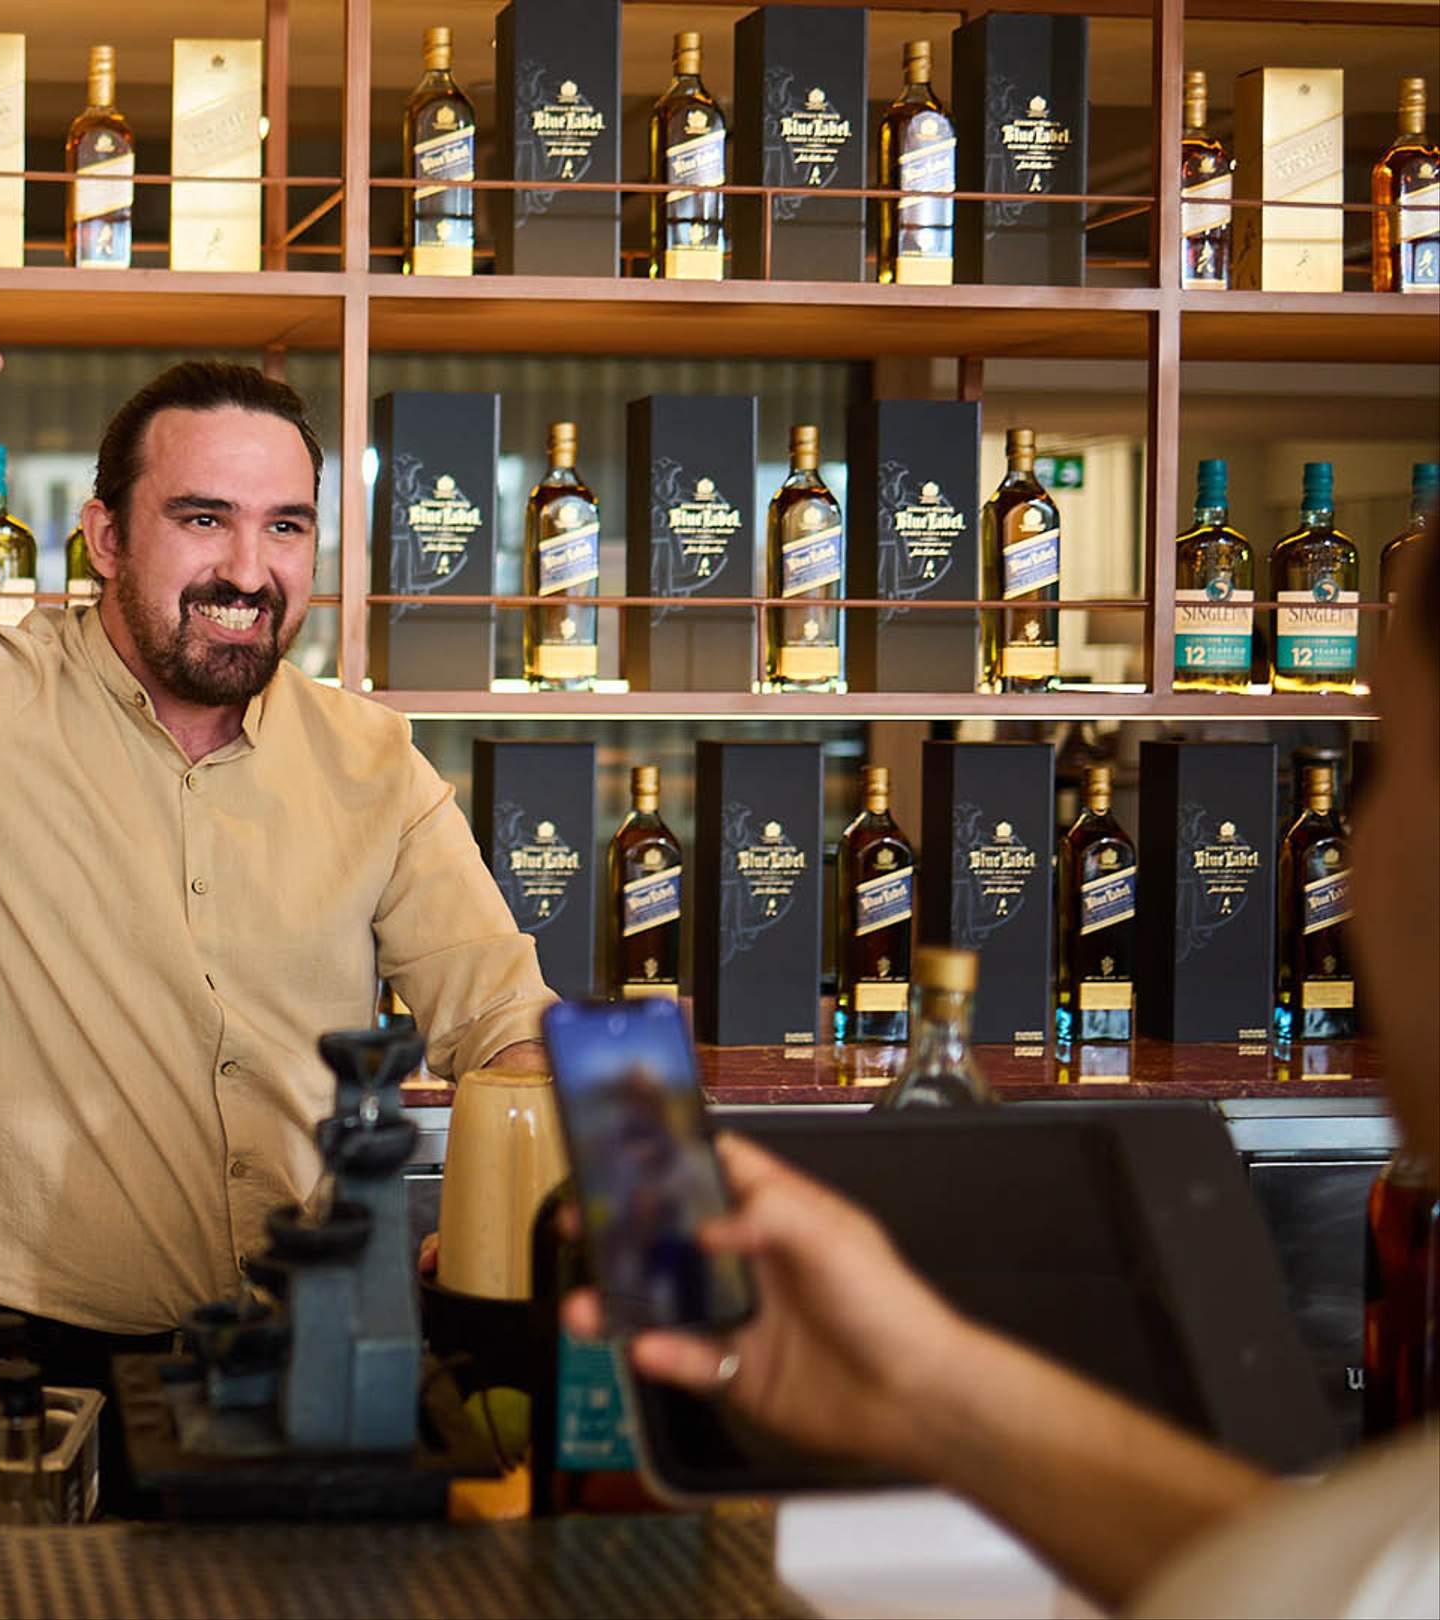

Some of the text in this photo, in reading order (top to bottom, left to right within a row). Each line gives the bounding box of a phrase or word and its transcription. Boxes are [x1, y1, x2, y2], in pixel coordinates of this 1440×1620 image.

[532, 112, 567, 129] Blue
[781, 118, 814, 136] Blue
[1002, 125, 1035, 143] Blue
[408, 507, 443, 525] Blue
[670, 509, 704, 528] Blue
[894, 511, 928, 530] Blue
[1185, 646, 1206, 665] 12
[1291, 647, 1313, 666] 12
[510, 850, 543, 870] Blue
[737, 851, 770, 870] Blue
[968, 851, 1000, 869] Blue
[1193, 851, 1224, 868] Blue
[1083, 883, 1130, 911] Blue Label
